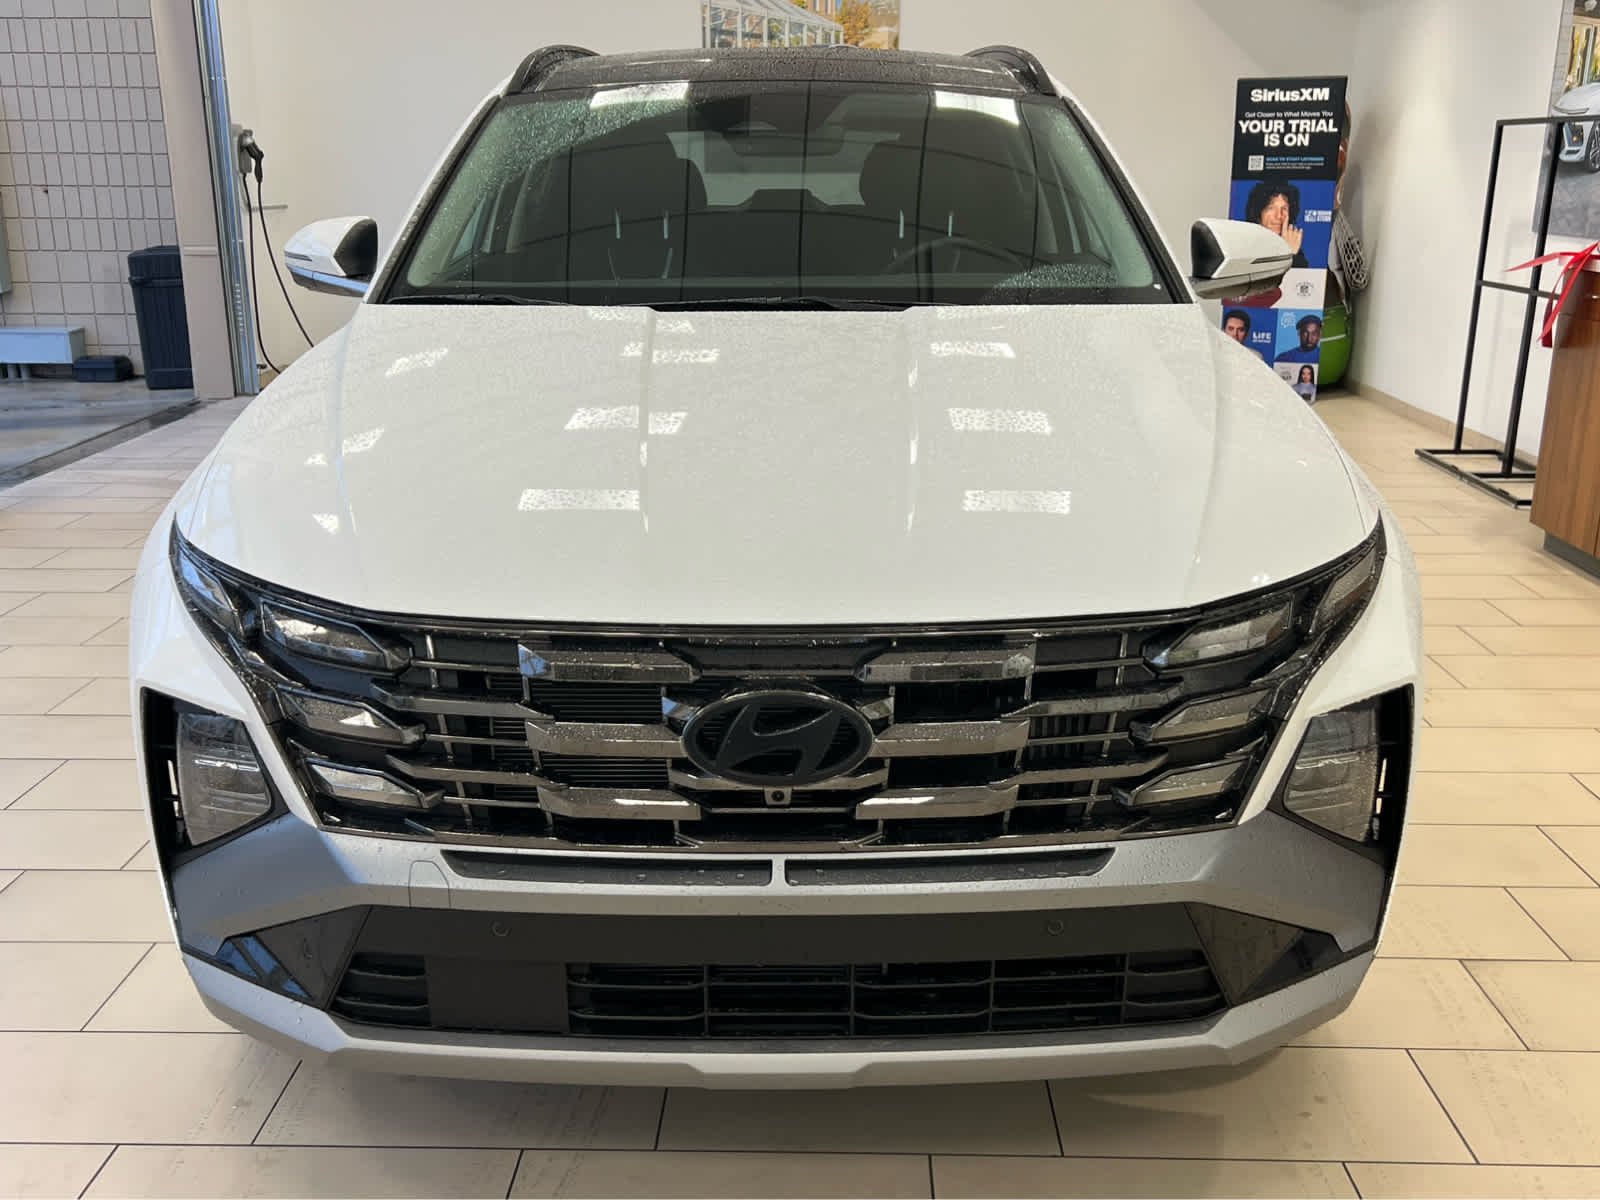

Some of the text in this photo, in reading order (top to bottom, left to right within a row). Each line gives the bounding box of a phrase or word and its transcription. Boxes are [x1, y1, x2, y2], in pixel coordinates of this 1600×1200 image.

[1250, 88, 1330, 102] SiriusXM
[1239, 118, 1338, 134] YOUR TRIAL
[1263, 133, 1310, 147] IS ON
